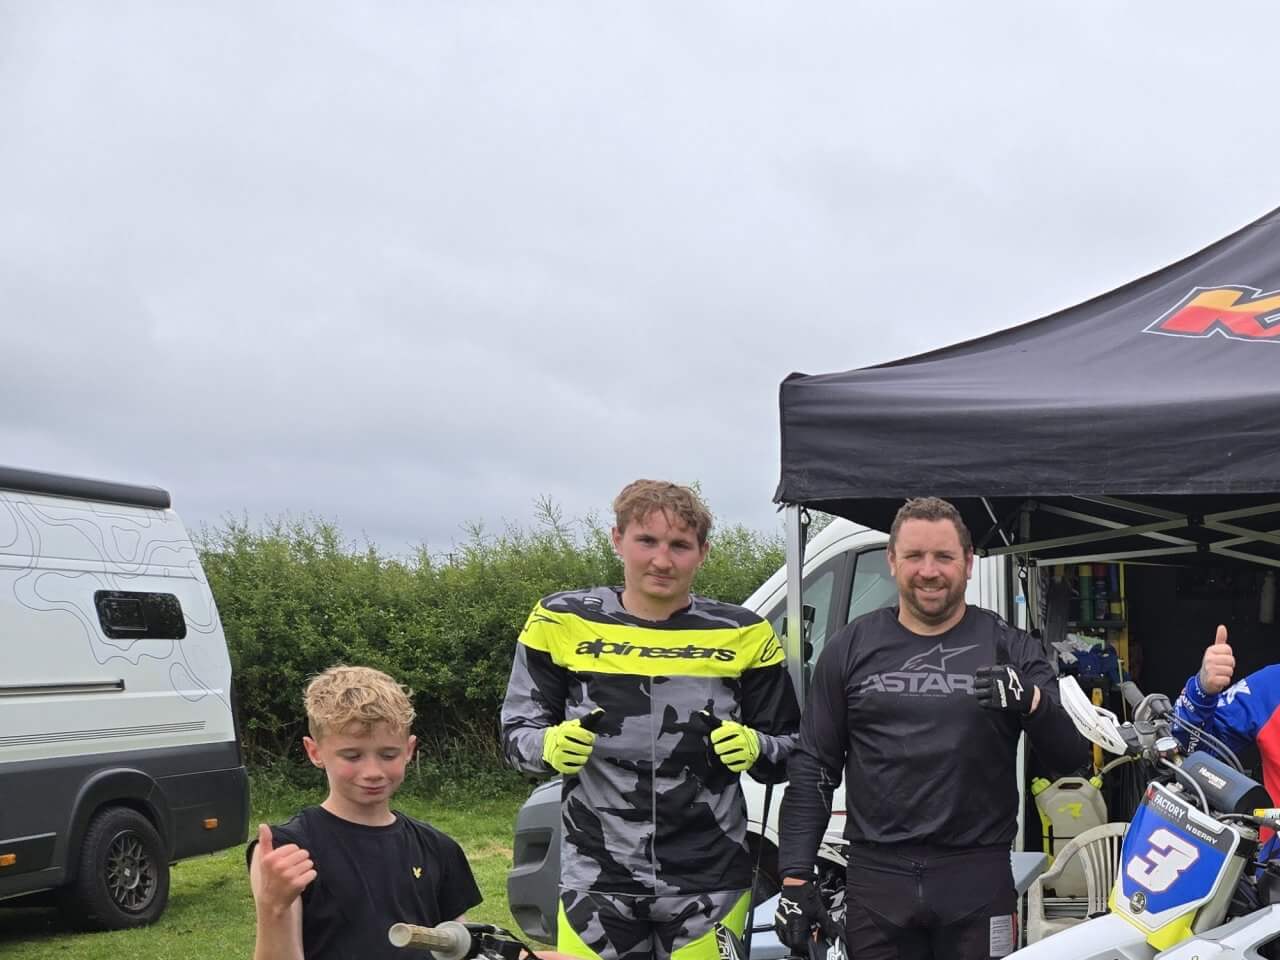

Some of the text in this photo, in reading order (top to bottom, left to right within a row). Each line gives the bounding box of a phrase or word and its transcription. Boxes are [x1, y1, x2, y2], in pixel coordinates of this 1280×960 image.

[575, 638, 737, 662] alpinestars
[858, 671, 978, 695] ASTAR
[1154, 794, 1186, 819] FACTORY
[1126, 828, 1199, 893] 3
